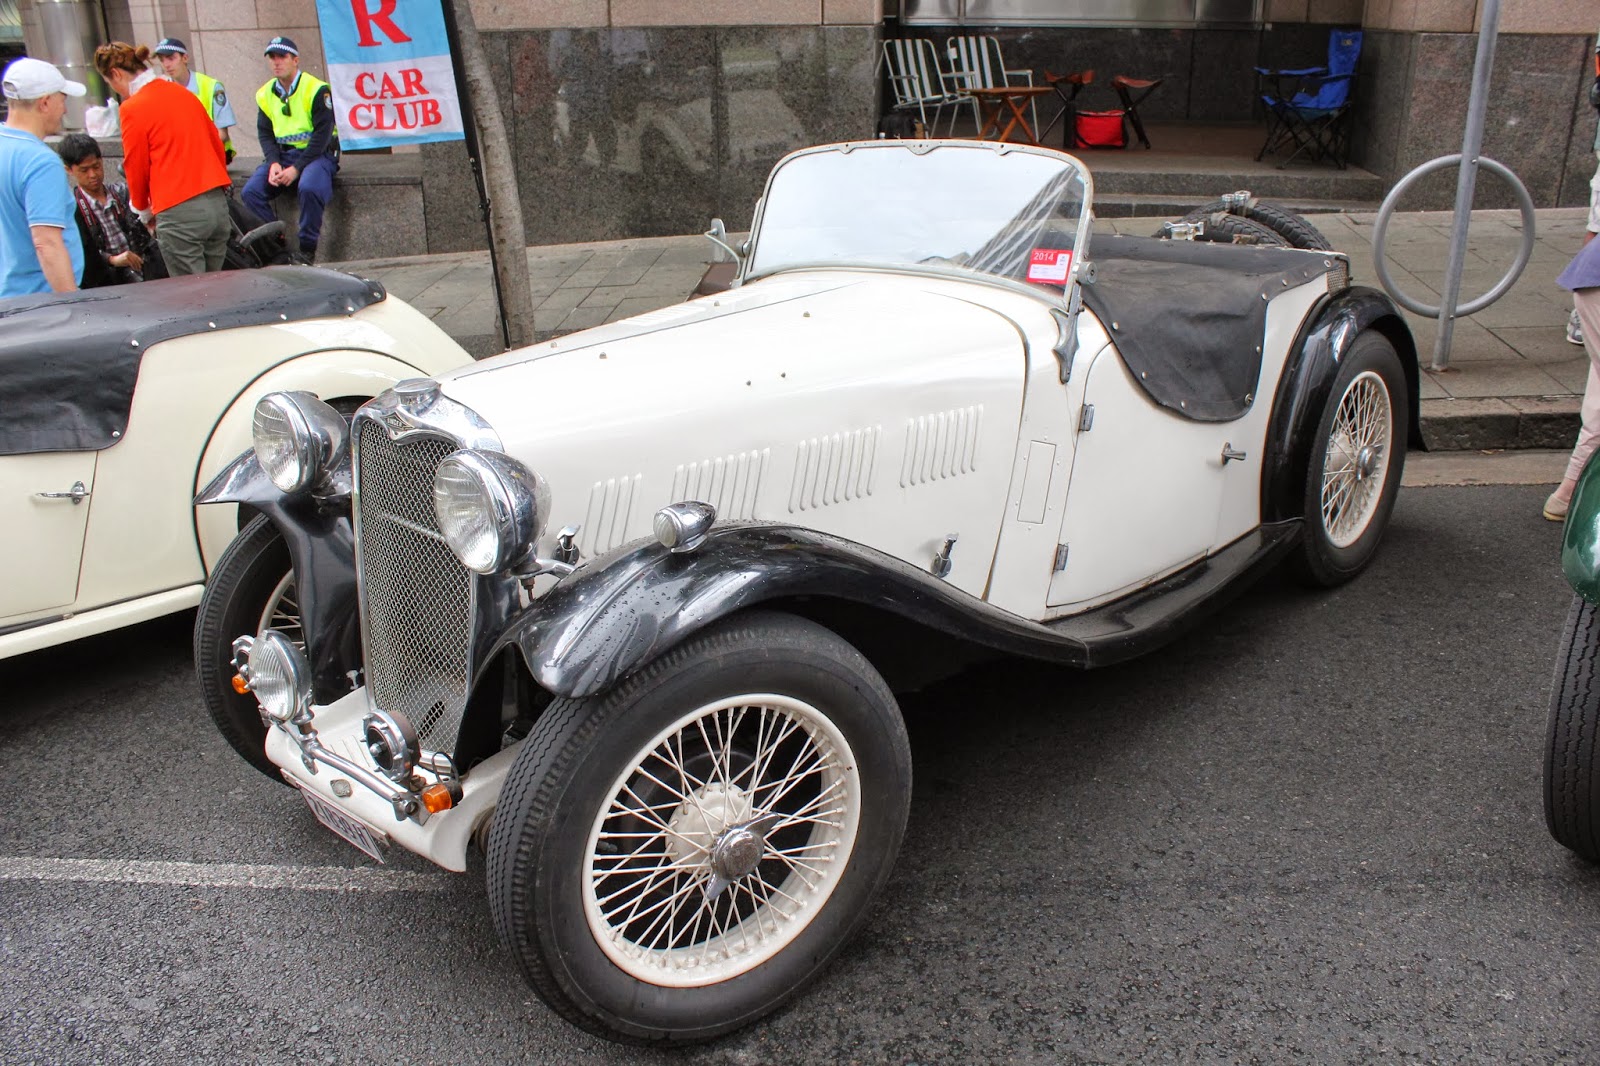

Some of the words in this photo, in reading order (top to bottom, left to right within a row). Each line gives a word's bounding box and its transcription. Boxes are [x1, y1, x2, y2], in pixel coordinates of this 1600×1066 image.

[351, 0, 413, 47] R
[354, 68, 430, 100] CAR
[348, 98, 443, 131] CLUB
[1033, 252, 1055, 261] 2014
